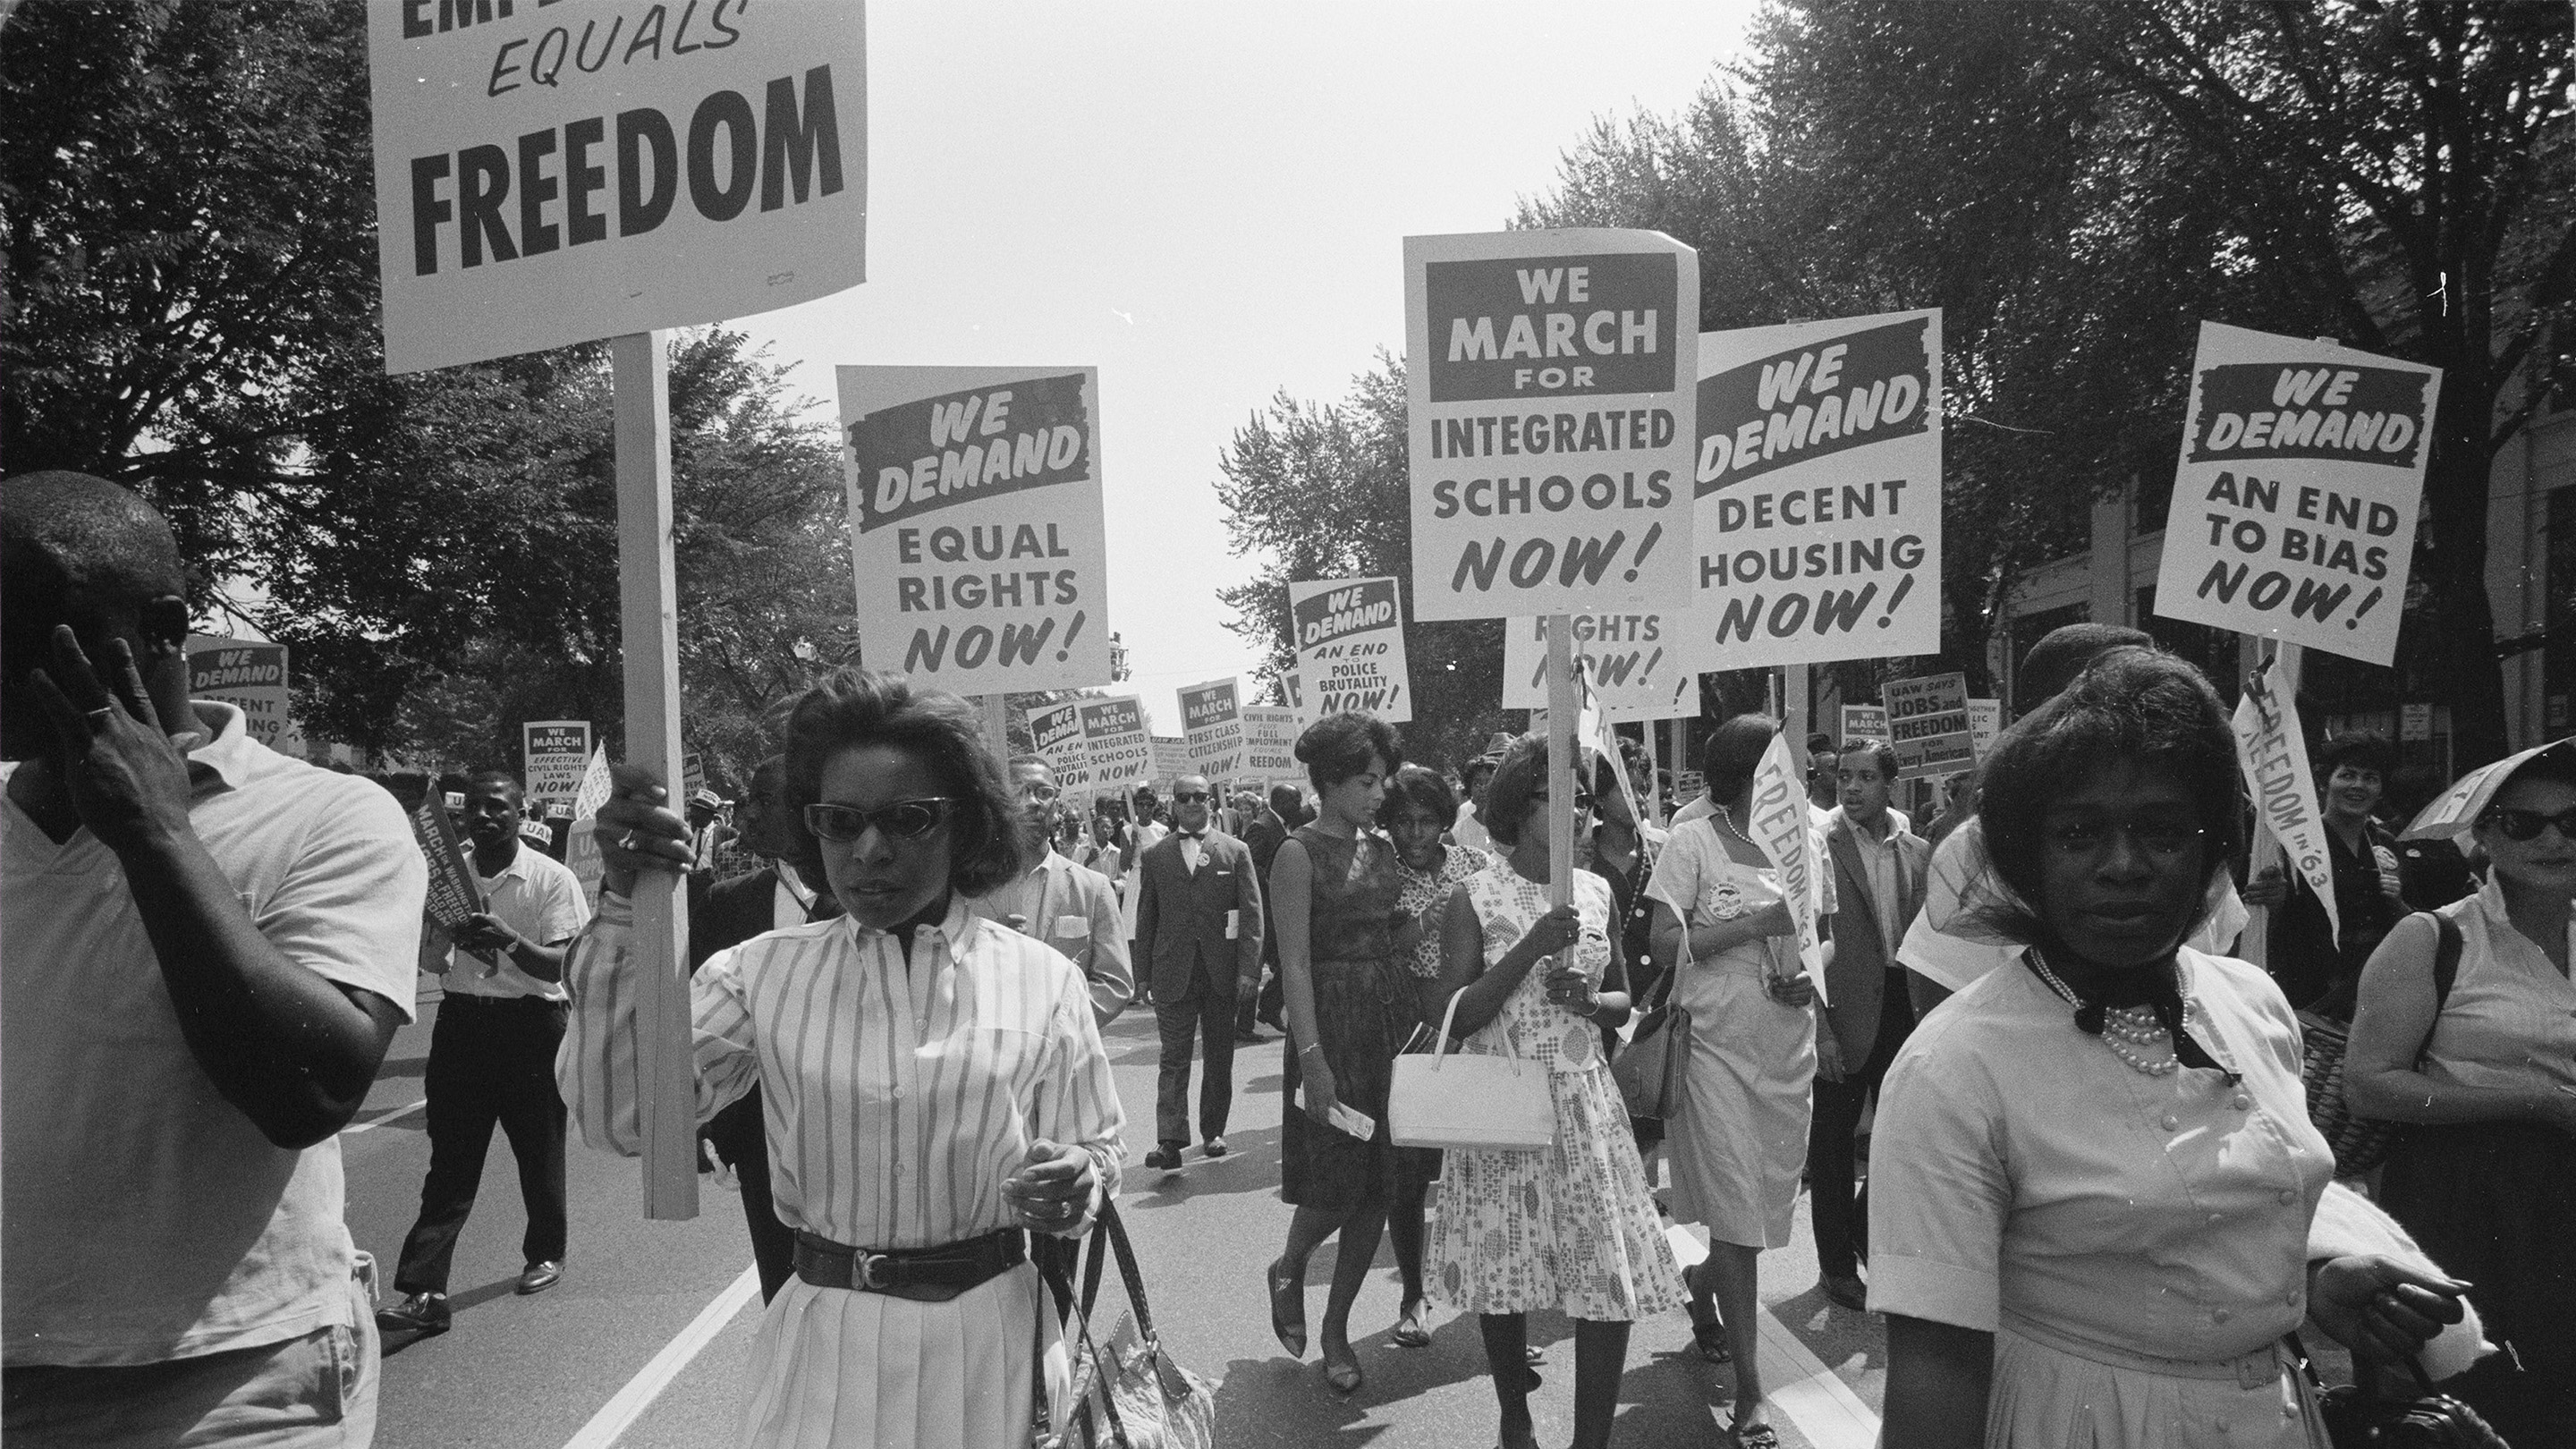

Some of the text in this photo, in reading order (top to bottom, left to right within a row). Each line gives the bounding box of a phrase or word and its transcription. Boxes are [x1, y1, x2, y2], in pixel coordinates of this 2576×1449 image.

[487, 0, 750, 97] EQUALS
[411, 63, 844, 276] FREEDOM
[1515, 267, 1589, 305] WE
[1447, 309, 1657, 362] MARCH
[1514, 366, 1596, 390] FOR
[1758, 343, 1848, 411] WE
[2272, 368, 2360, 407] WE
[929, 390, 1013, 447] WE
[1696, 374, 1920, 483] DEMAND
[1431, 408, 1675, 459] INTEGRATED
[2206, 409, 2415, 453] DEMAND
[874, 425, 1081, 513] DEMAND
[1432, 470, 1673, 519] SCHOOLS
[1718, 479, 1907, 533] DECENT
[2205, 470, 2399, 537] AN END
[898, 523, 1070, 564] EQUAL
[2206, 513, 2388, 580] TO BIAS
[1451, 521, 1663, 593] NOW!
[1699, 534, 1926, 589] HOUSING
[898, 569, 1079, 612] RIGHTS
[1328, 587, 1363, 614] WE
[2196, 559, 2383, 631] NOW!
[1715, 572, 1915, 645] NOW!
[1305, 600, 1392, 644] DEMAND
[1535, 614, 1660, 641] RGHTS
[903, 609, 1087, 674] NOW!
[1314, 642, 1388, 660] AN END
[218, 649, 253, 667] WE
[1331, 662, 1377, 677] POLICE
[196, 665, 279, 689] DEMAND
[1319, 675, 1387, 692] BRUTALITY
[1892, 679, 1956, 697] UAW SAYS
[1201, 690, 1216, 702] WE
[1320, 683, 1400, 715] NOW!
[1891, 695, 1962, 717] JOBS and
[1051, 707, 1073, 726] WE
[1100, 704, 1118, 715] WE
[1189, 698, 1233, 719] MARCH
[1204, 715, 1221, 724] FOR
[1243, 714, 1263, 722] CIVIL
[1267, 714, 1293, 723] RIGHTS
[547, 728, 565, 736] WE
[1039, 718, 1080, 747] DEMA
[1087, 712, 1137, 730] MARCH
[1104, 725, 1124, 734] FOR
[1849, 719, 1887, 729] MARCH
[1892, 714, 1967, 741] FREEDOM
[532, 736, 581, 748] MARCH
[1087, 733, 1145, 751] INTEGRATED
[1188, 724, 1241, 745] FIRST CLASS
[1258, 729, 1278, 738] FULL
[1046, 744, 1063, 756] AN
[1067, 741, 1082, 751] EN
[1090, 747, 1148, 765] SCHOOLS
[1188, 736, 1243, 758] CITIZENSHIP
[534, 756, 583, 764] EFFECTIVE
[1051, 761, 1088, 775] BRUTALIT
[1057, 753, 1086, 766] POLICE
[1098, 758, 1148, 782] NOW!
[1199, 751, 1241, 776] NOW!
[1250, 756, 1292, 768] REEDOM
[534, 780, 583, 793] NOW!
[418, 804, 447, 857] MARCH
[2293, 833, 2309, 850] IN
